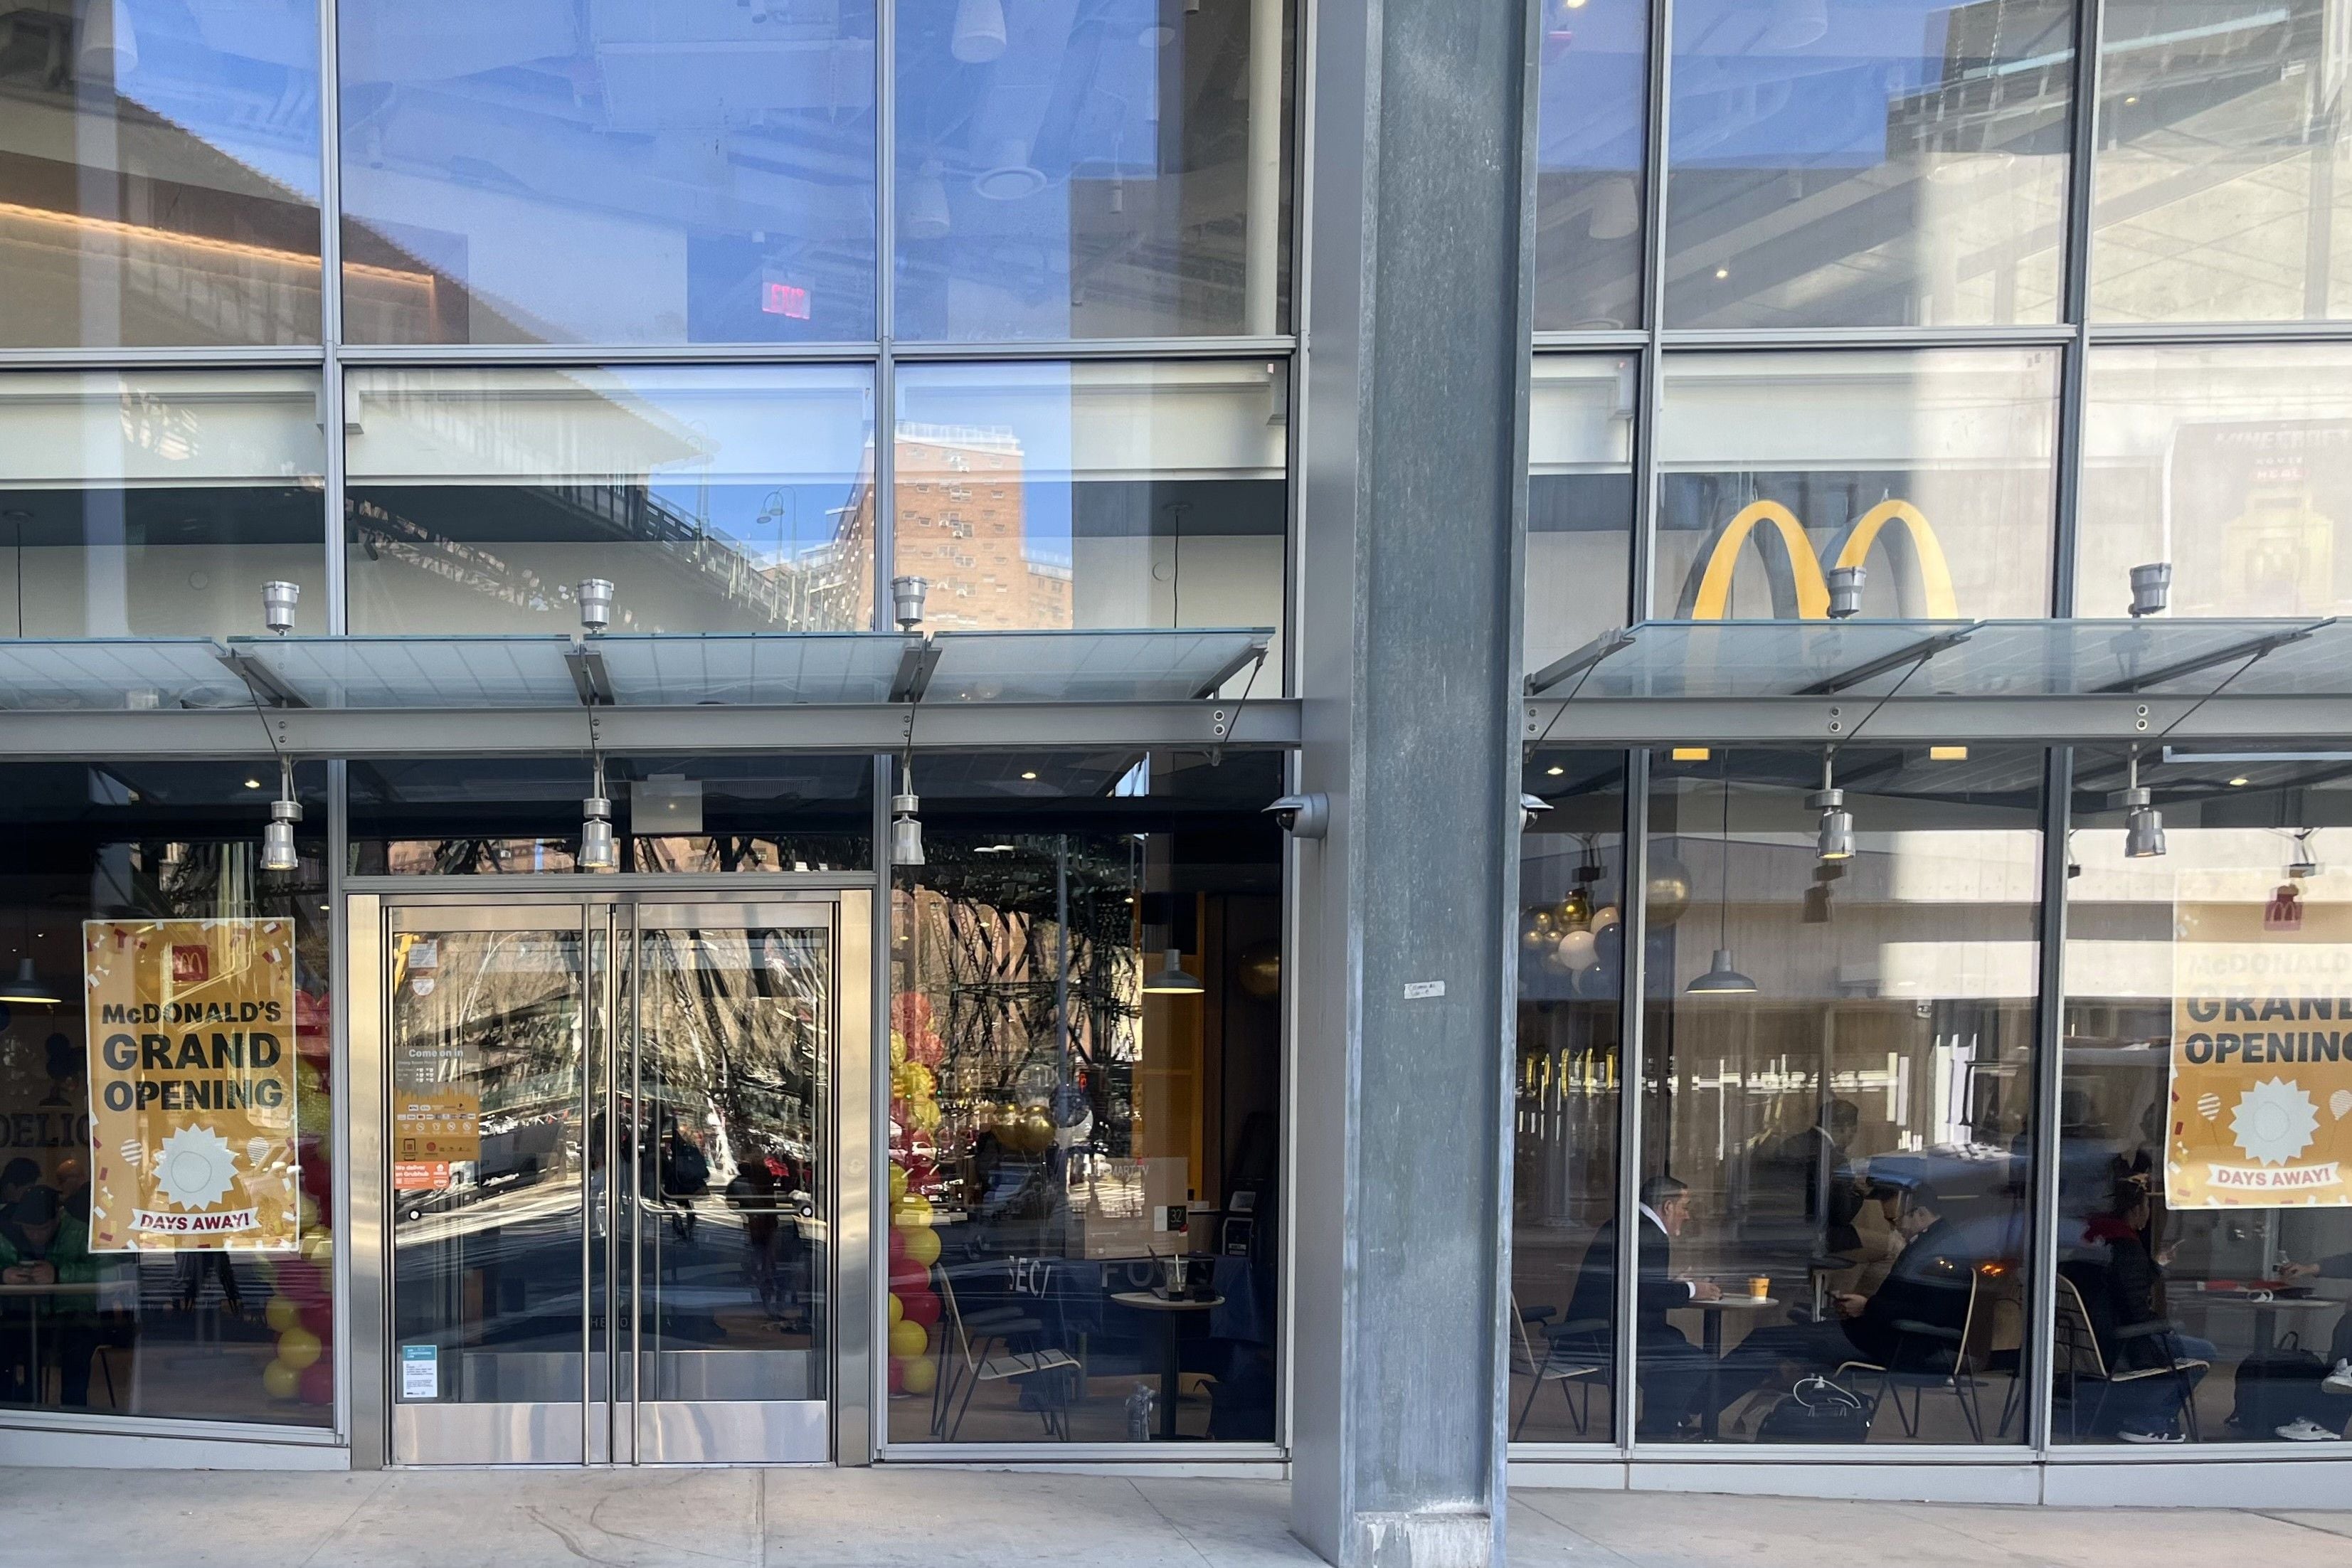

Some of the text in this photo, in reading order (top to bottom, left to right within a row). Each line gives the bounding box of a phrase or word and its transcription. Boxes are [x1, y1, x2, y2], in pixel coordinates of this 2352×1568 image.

[102, 1000, 282, 1024] McDONALD'S
[102, 1032, 282, 1071] GRAND
[408, 1049, 438, 1058] Come
[454, 1049, 464, 1058] in
[104, 1079, 284, 1111] OPENING
[2218, 1167, 2331, 1186] DAYS AWAY!
[139, 1212, 250, 1231] DAYS AWAY!
